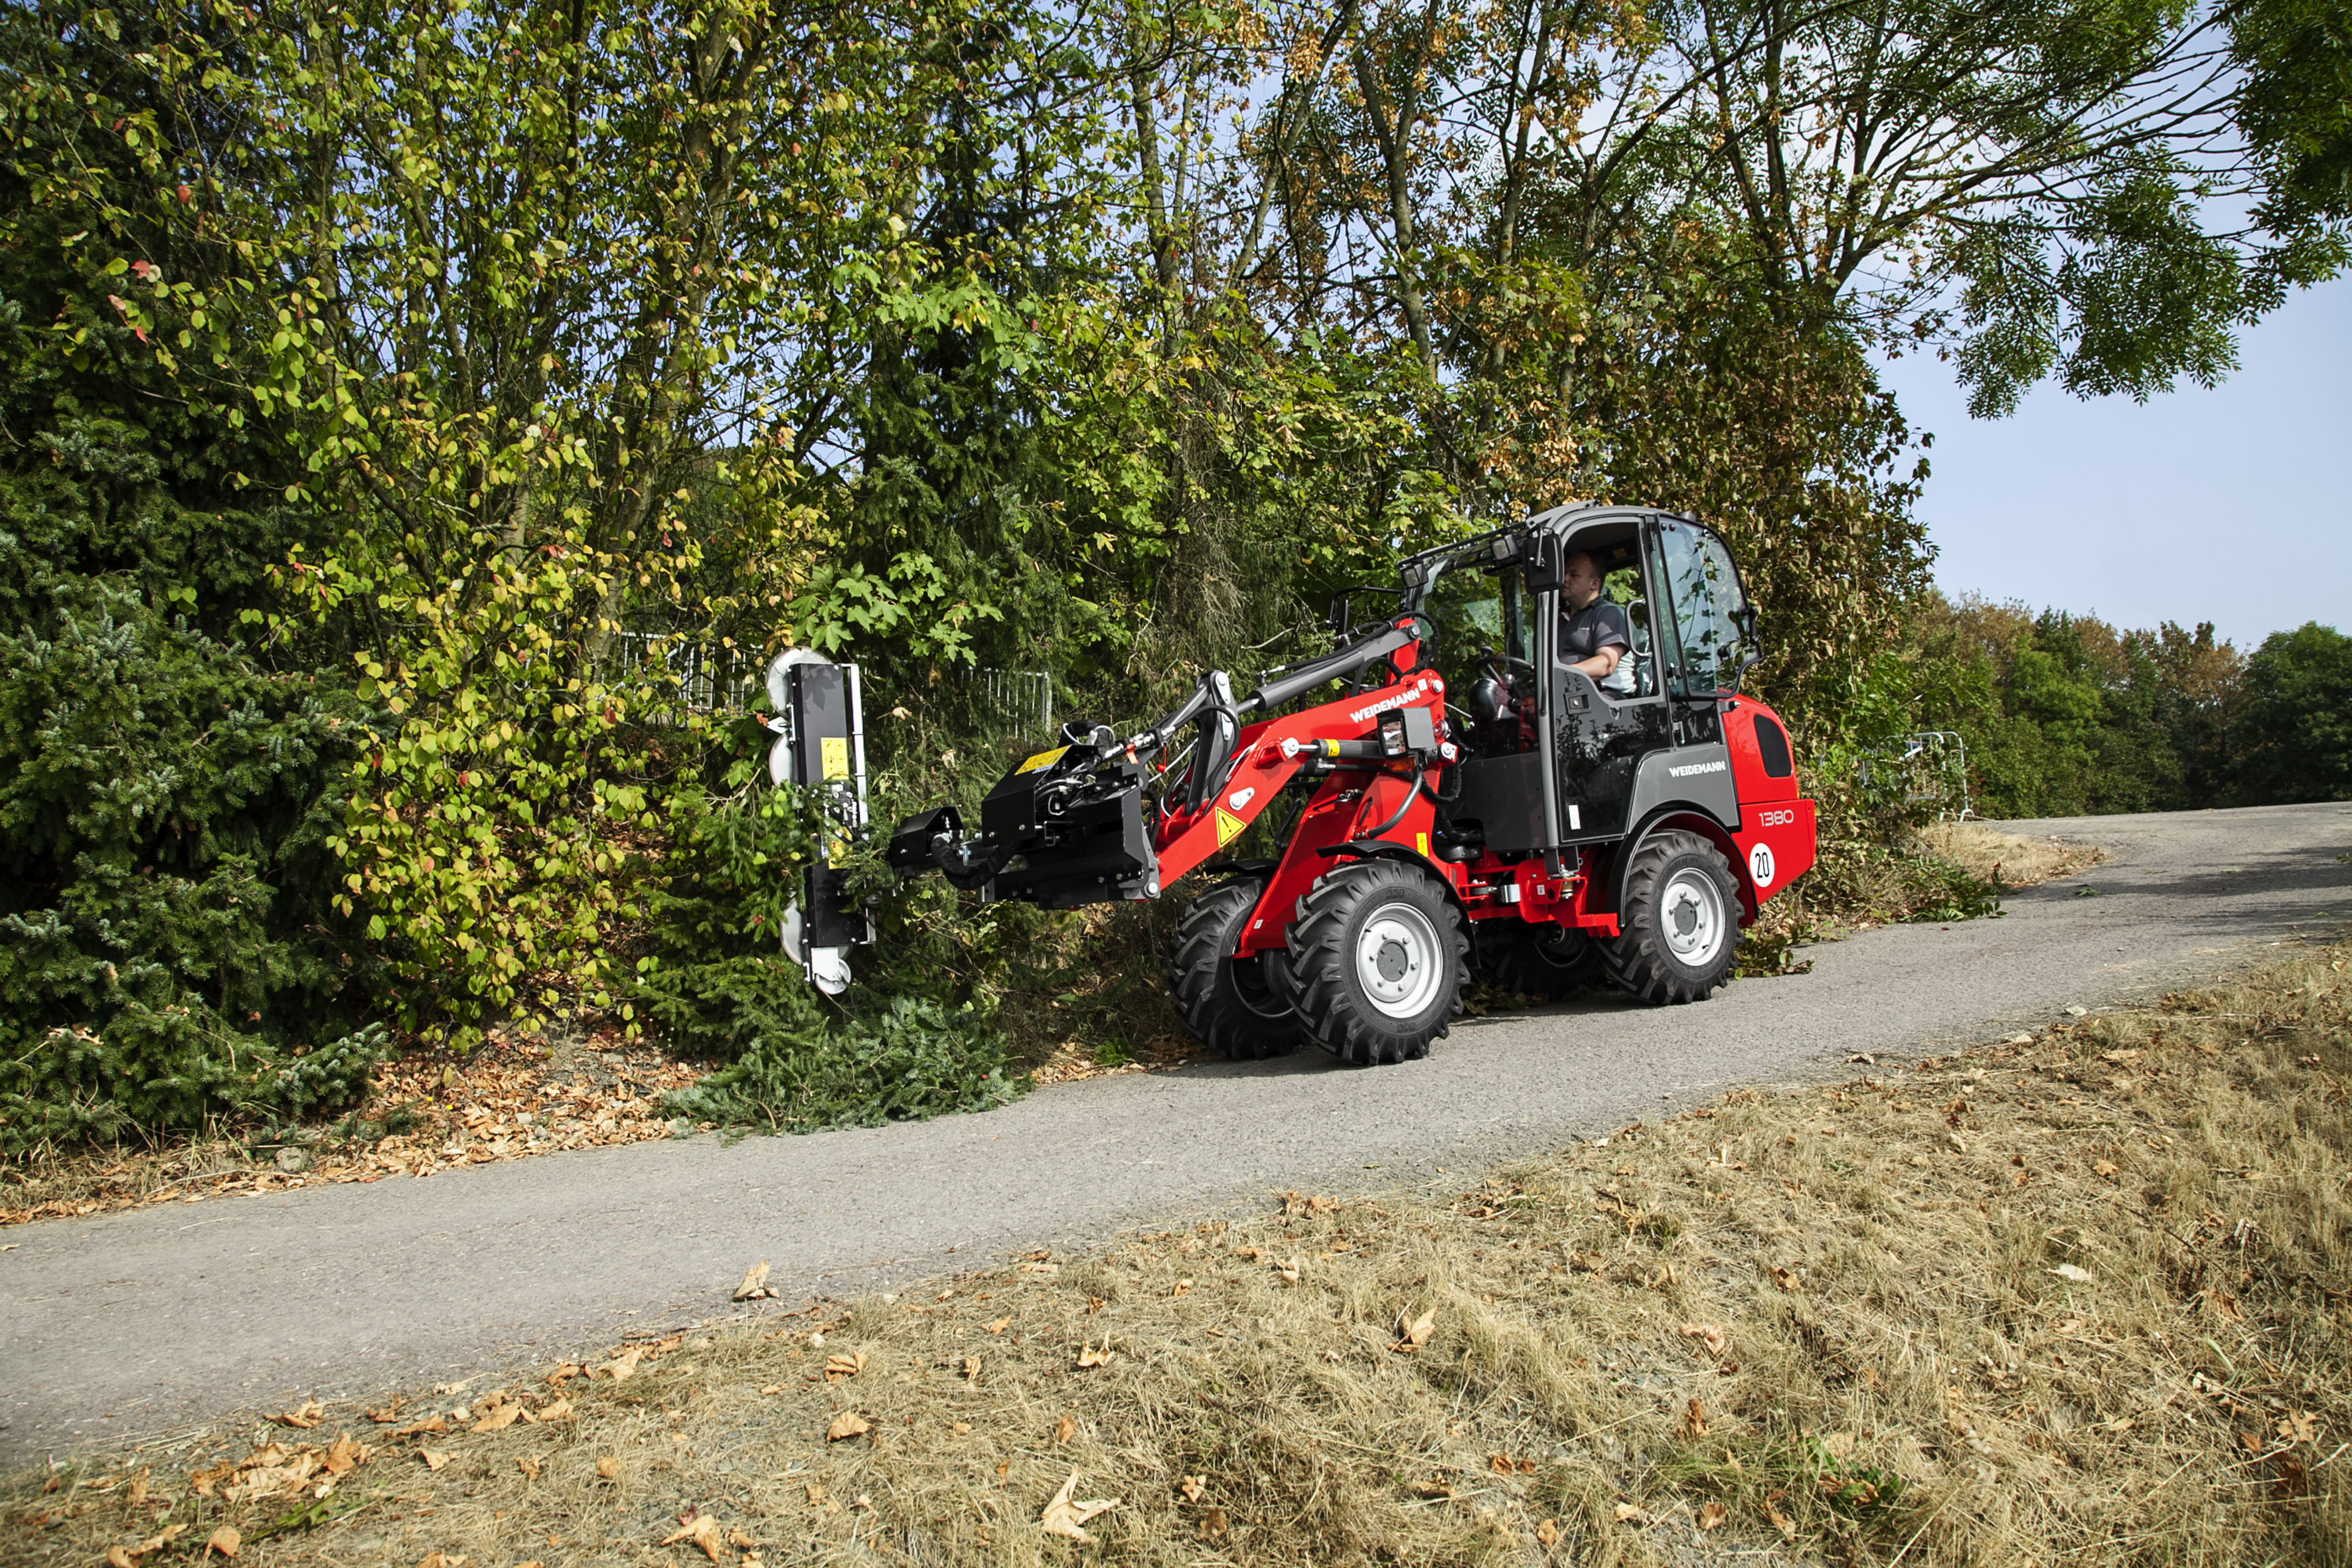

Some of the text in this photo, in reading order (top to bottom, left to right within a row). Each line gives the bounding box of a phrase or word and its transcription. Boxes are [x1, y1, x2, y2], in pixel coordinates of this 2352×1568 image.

[1350, 688, 1421, 723] WEIDEMANN
[1668, 760, 1726, 777] WEIDEMANN
[1759, 809, 1794, 826] 1380
[1755, 852, 1770, 878] 20
